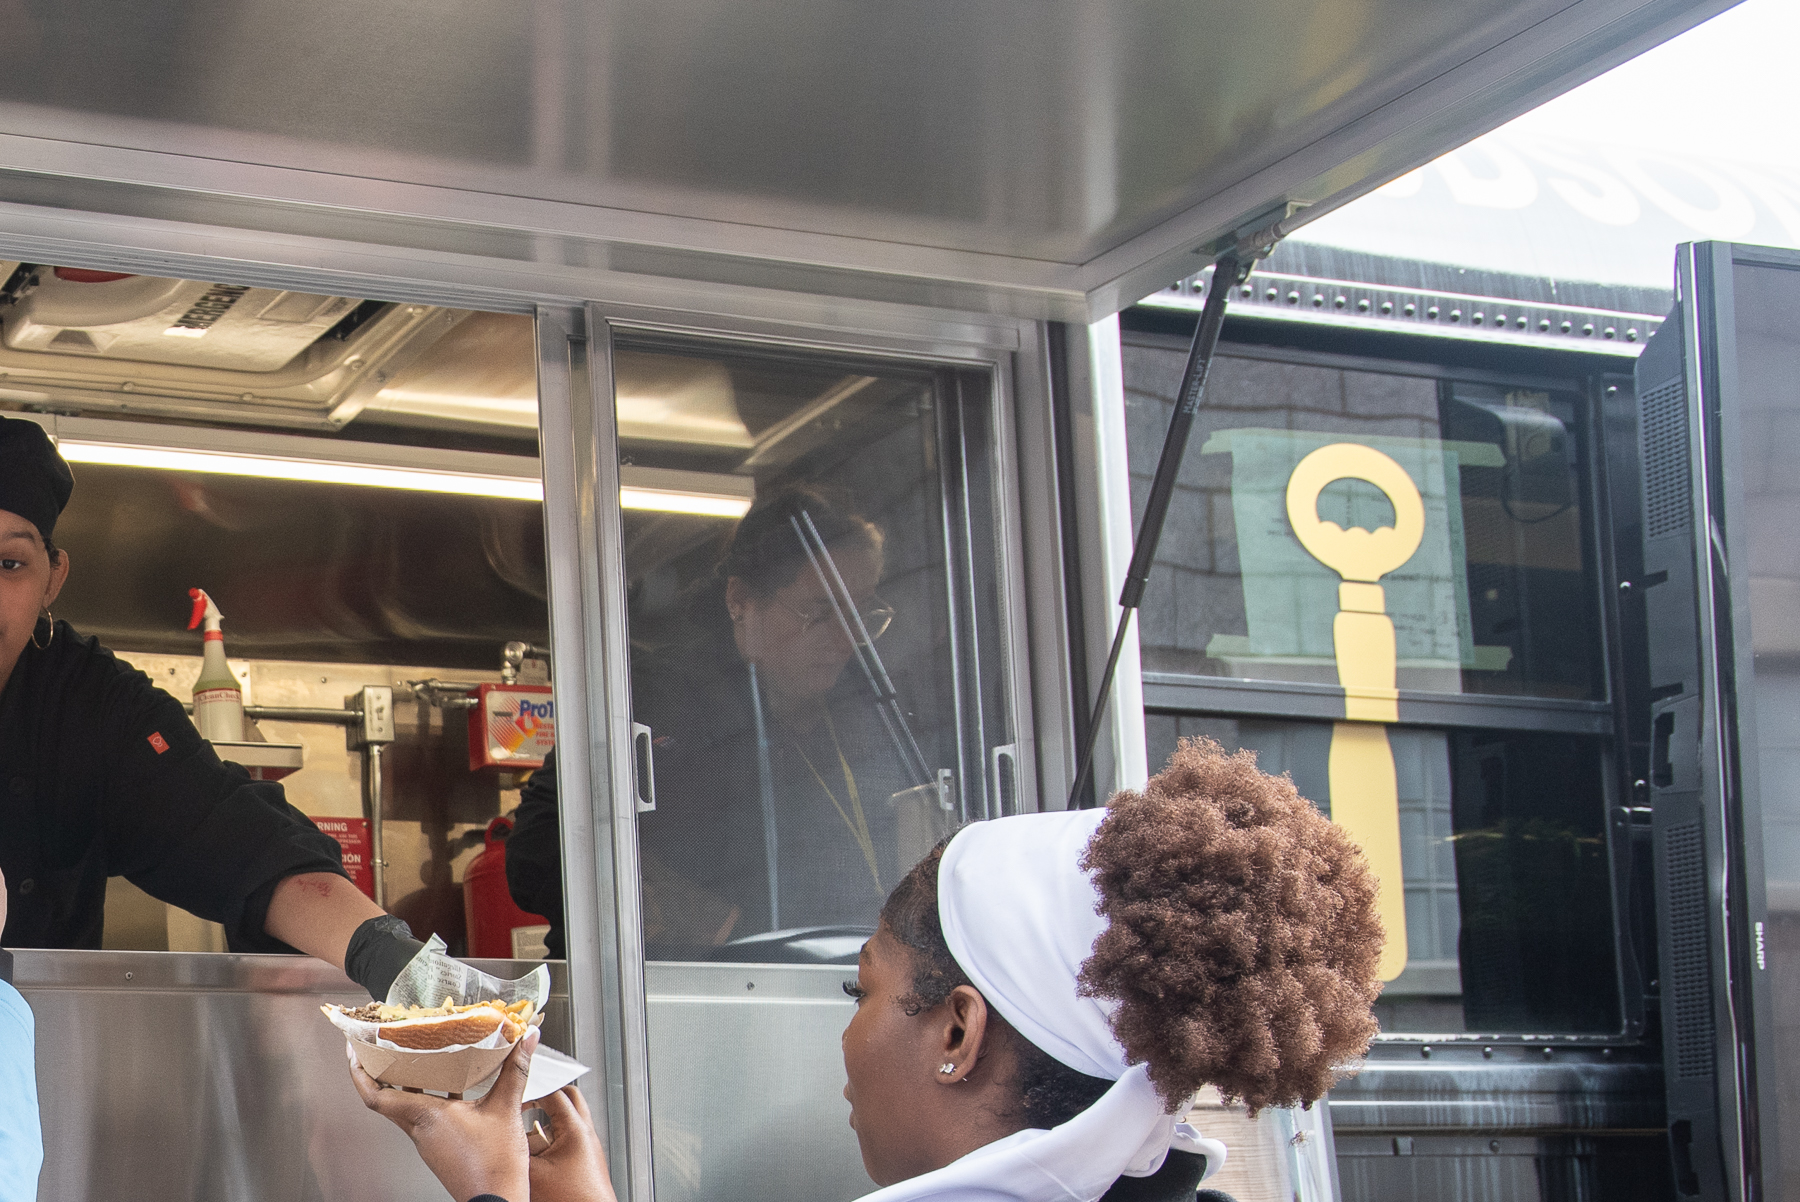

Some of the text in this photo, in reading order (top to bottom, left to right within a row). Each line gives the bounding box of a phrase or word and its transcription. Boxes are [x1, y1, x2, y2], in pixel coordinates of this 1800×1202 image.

[164, 284, 251, 337] MERGENC
[317, 821, 348, 832] RNING
[341, 852, 361, 864] IÓN
[1755, 921, 1766, 970] SHARP
